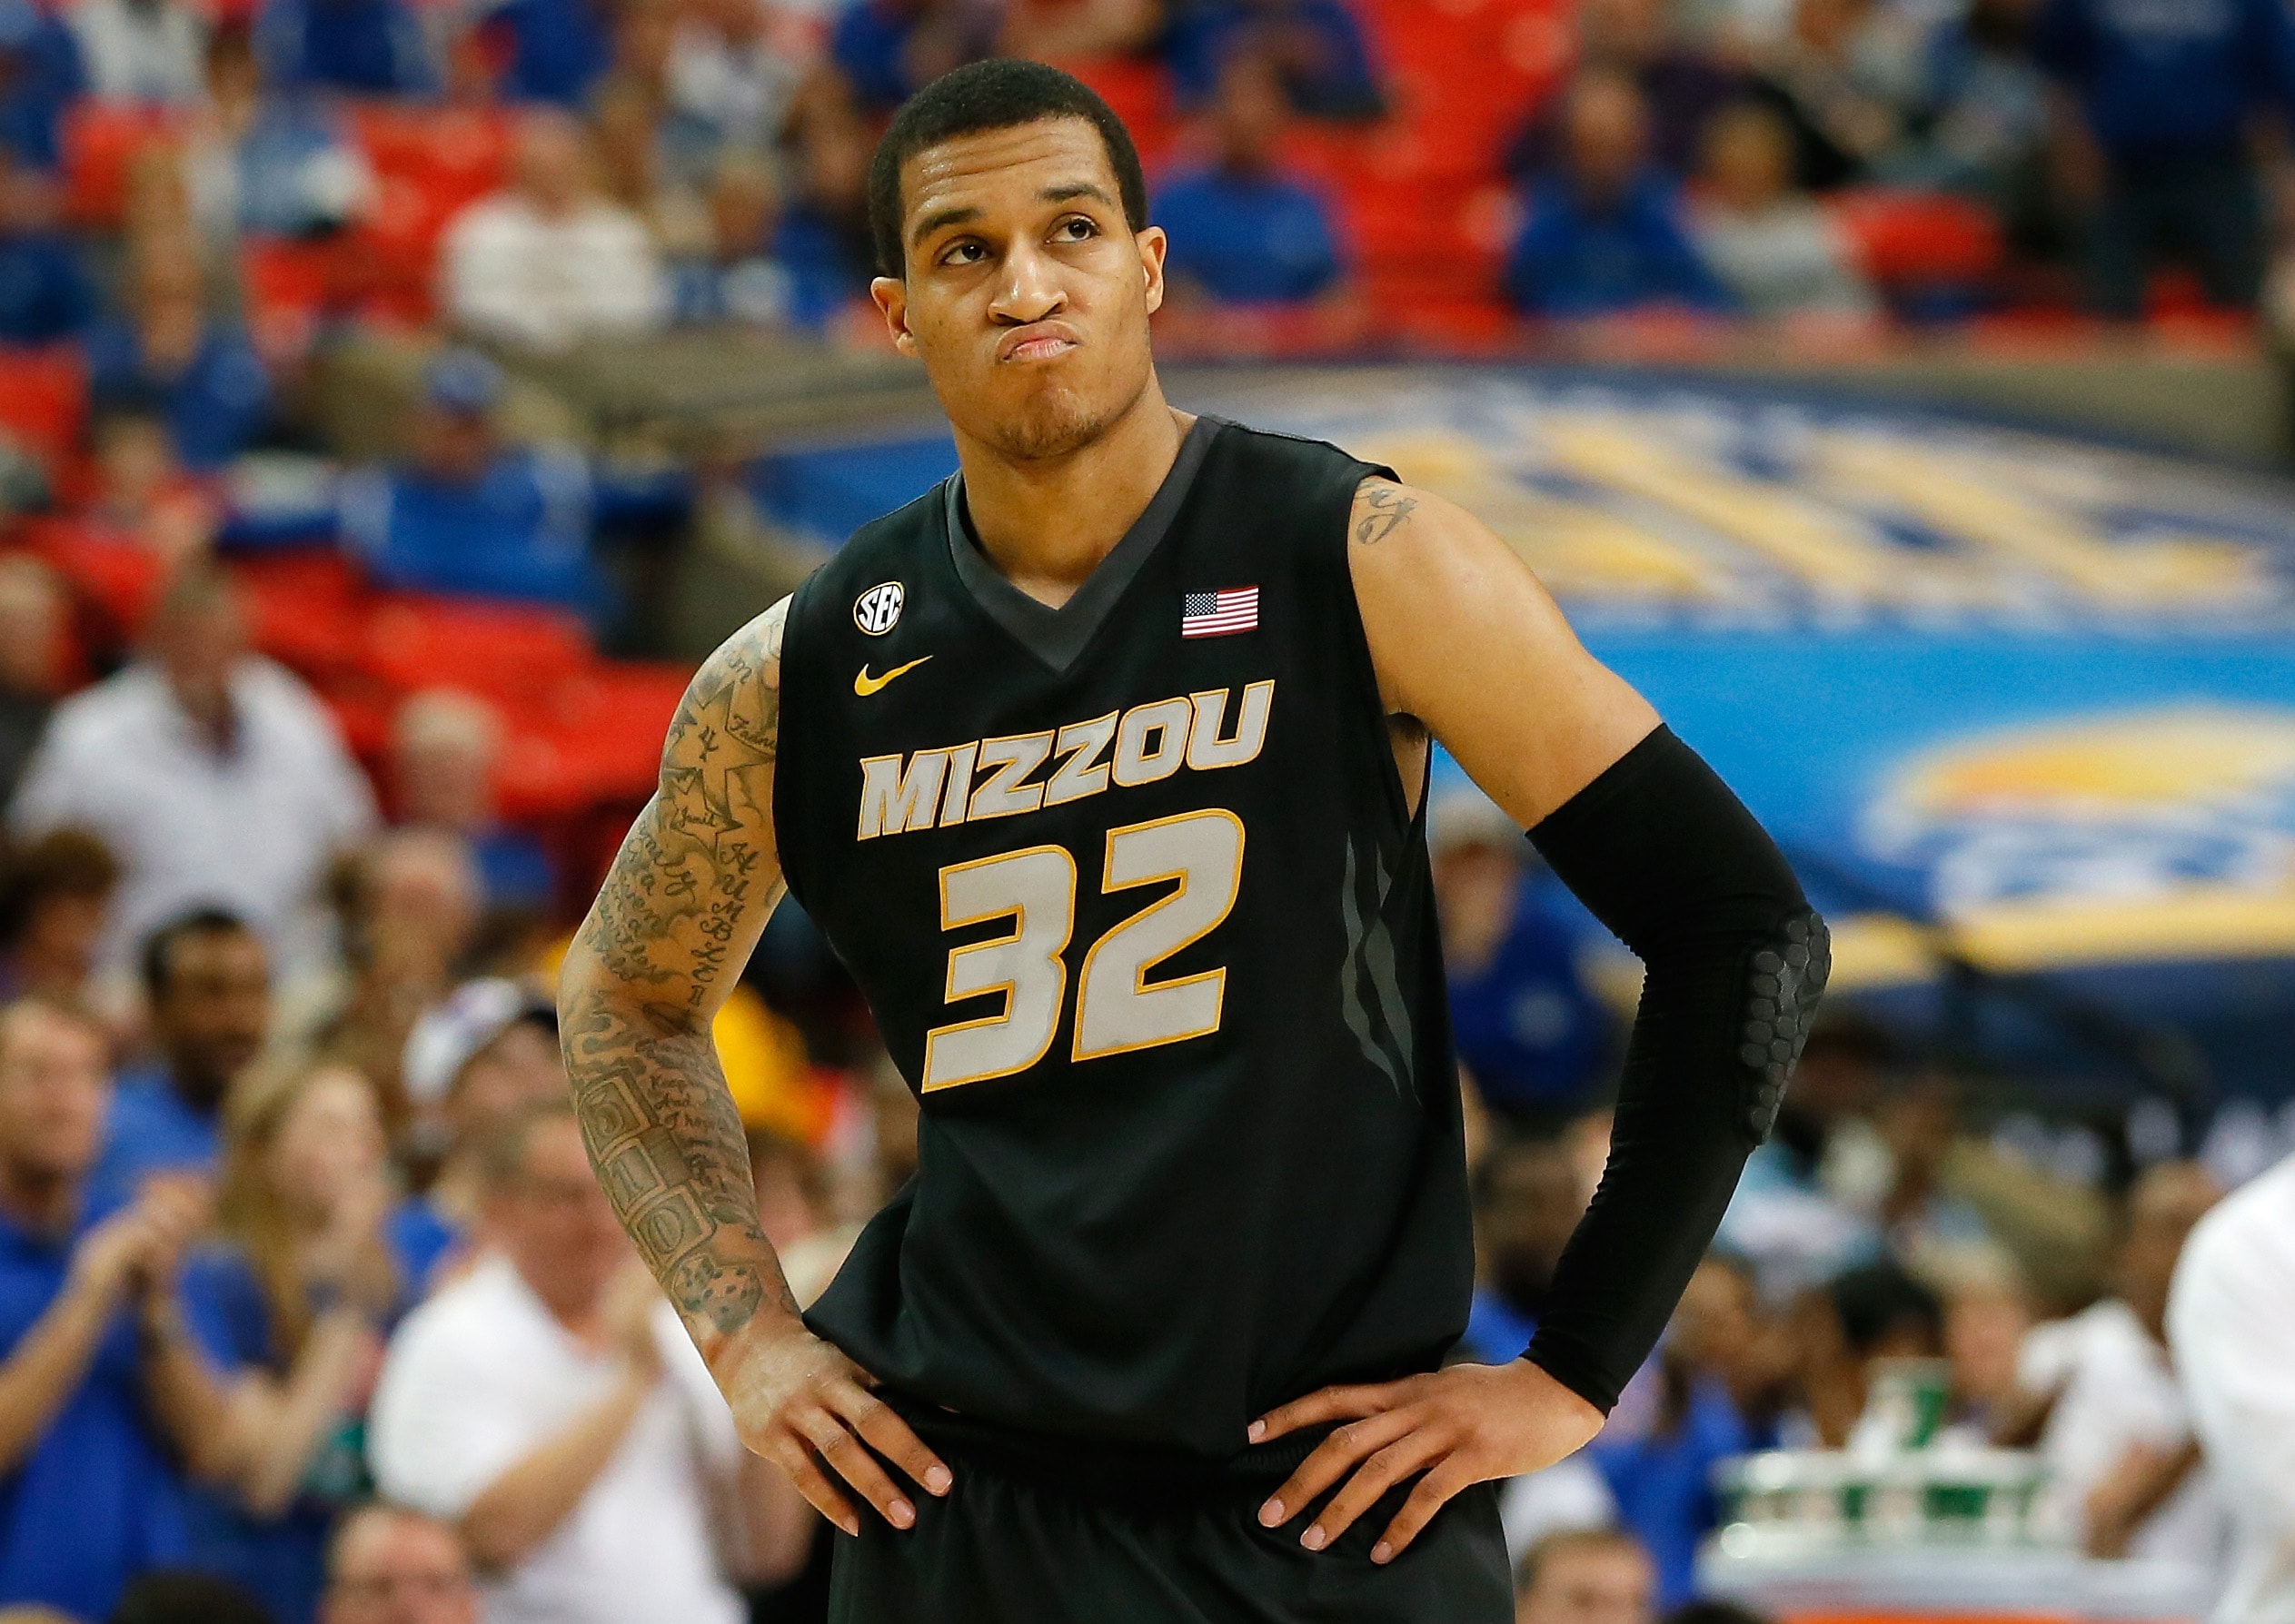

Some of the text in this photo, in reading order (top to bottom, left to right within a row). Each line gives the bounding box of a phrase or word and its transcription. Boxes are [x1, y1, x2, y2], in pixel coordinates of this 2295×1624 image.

[857, 584, 902, 633] SEC
[857, 678, 1275, 841] MIZZOU
[920, 807, 1246, 1094] 32
